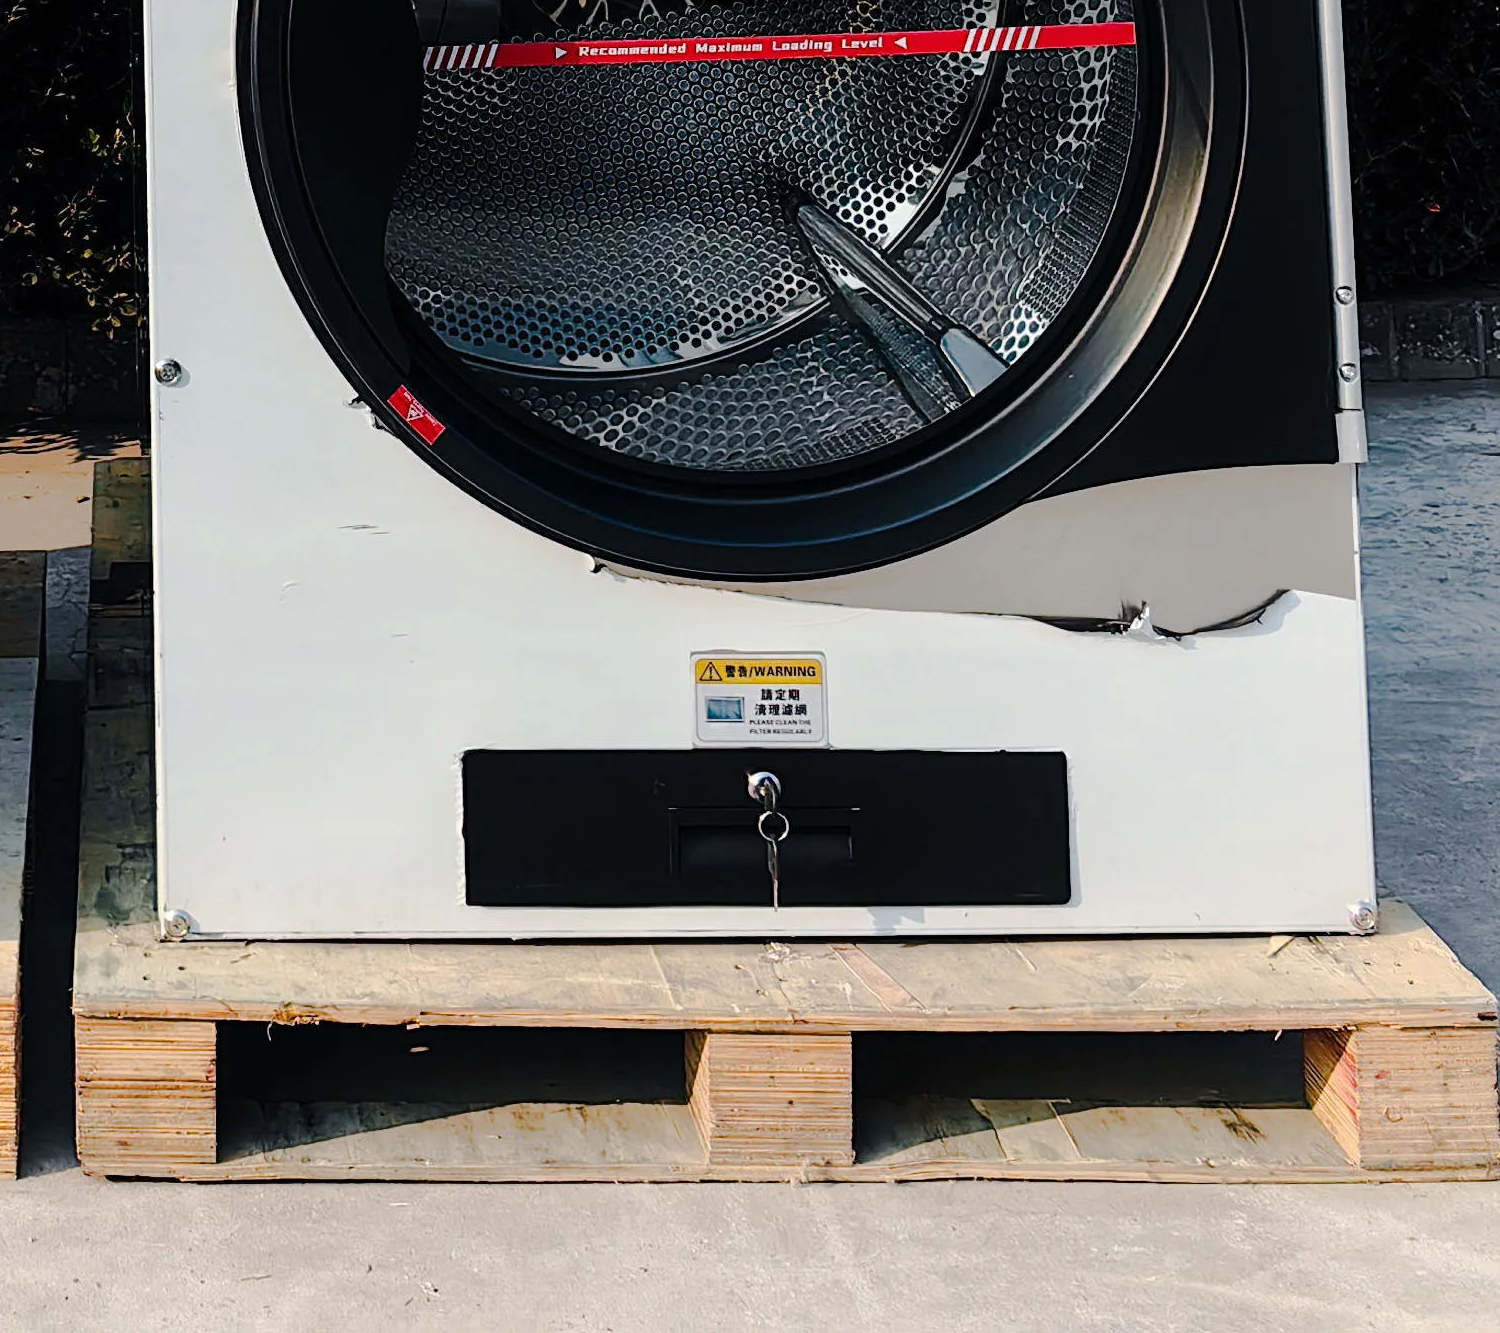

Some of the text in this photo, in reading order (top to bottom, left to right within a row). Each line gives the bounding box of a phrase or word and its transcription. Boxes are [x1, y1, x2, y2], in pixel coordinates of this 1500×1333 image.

[578, 36, 885, 58] Recommended Maximum Loading Level
